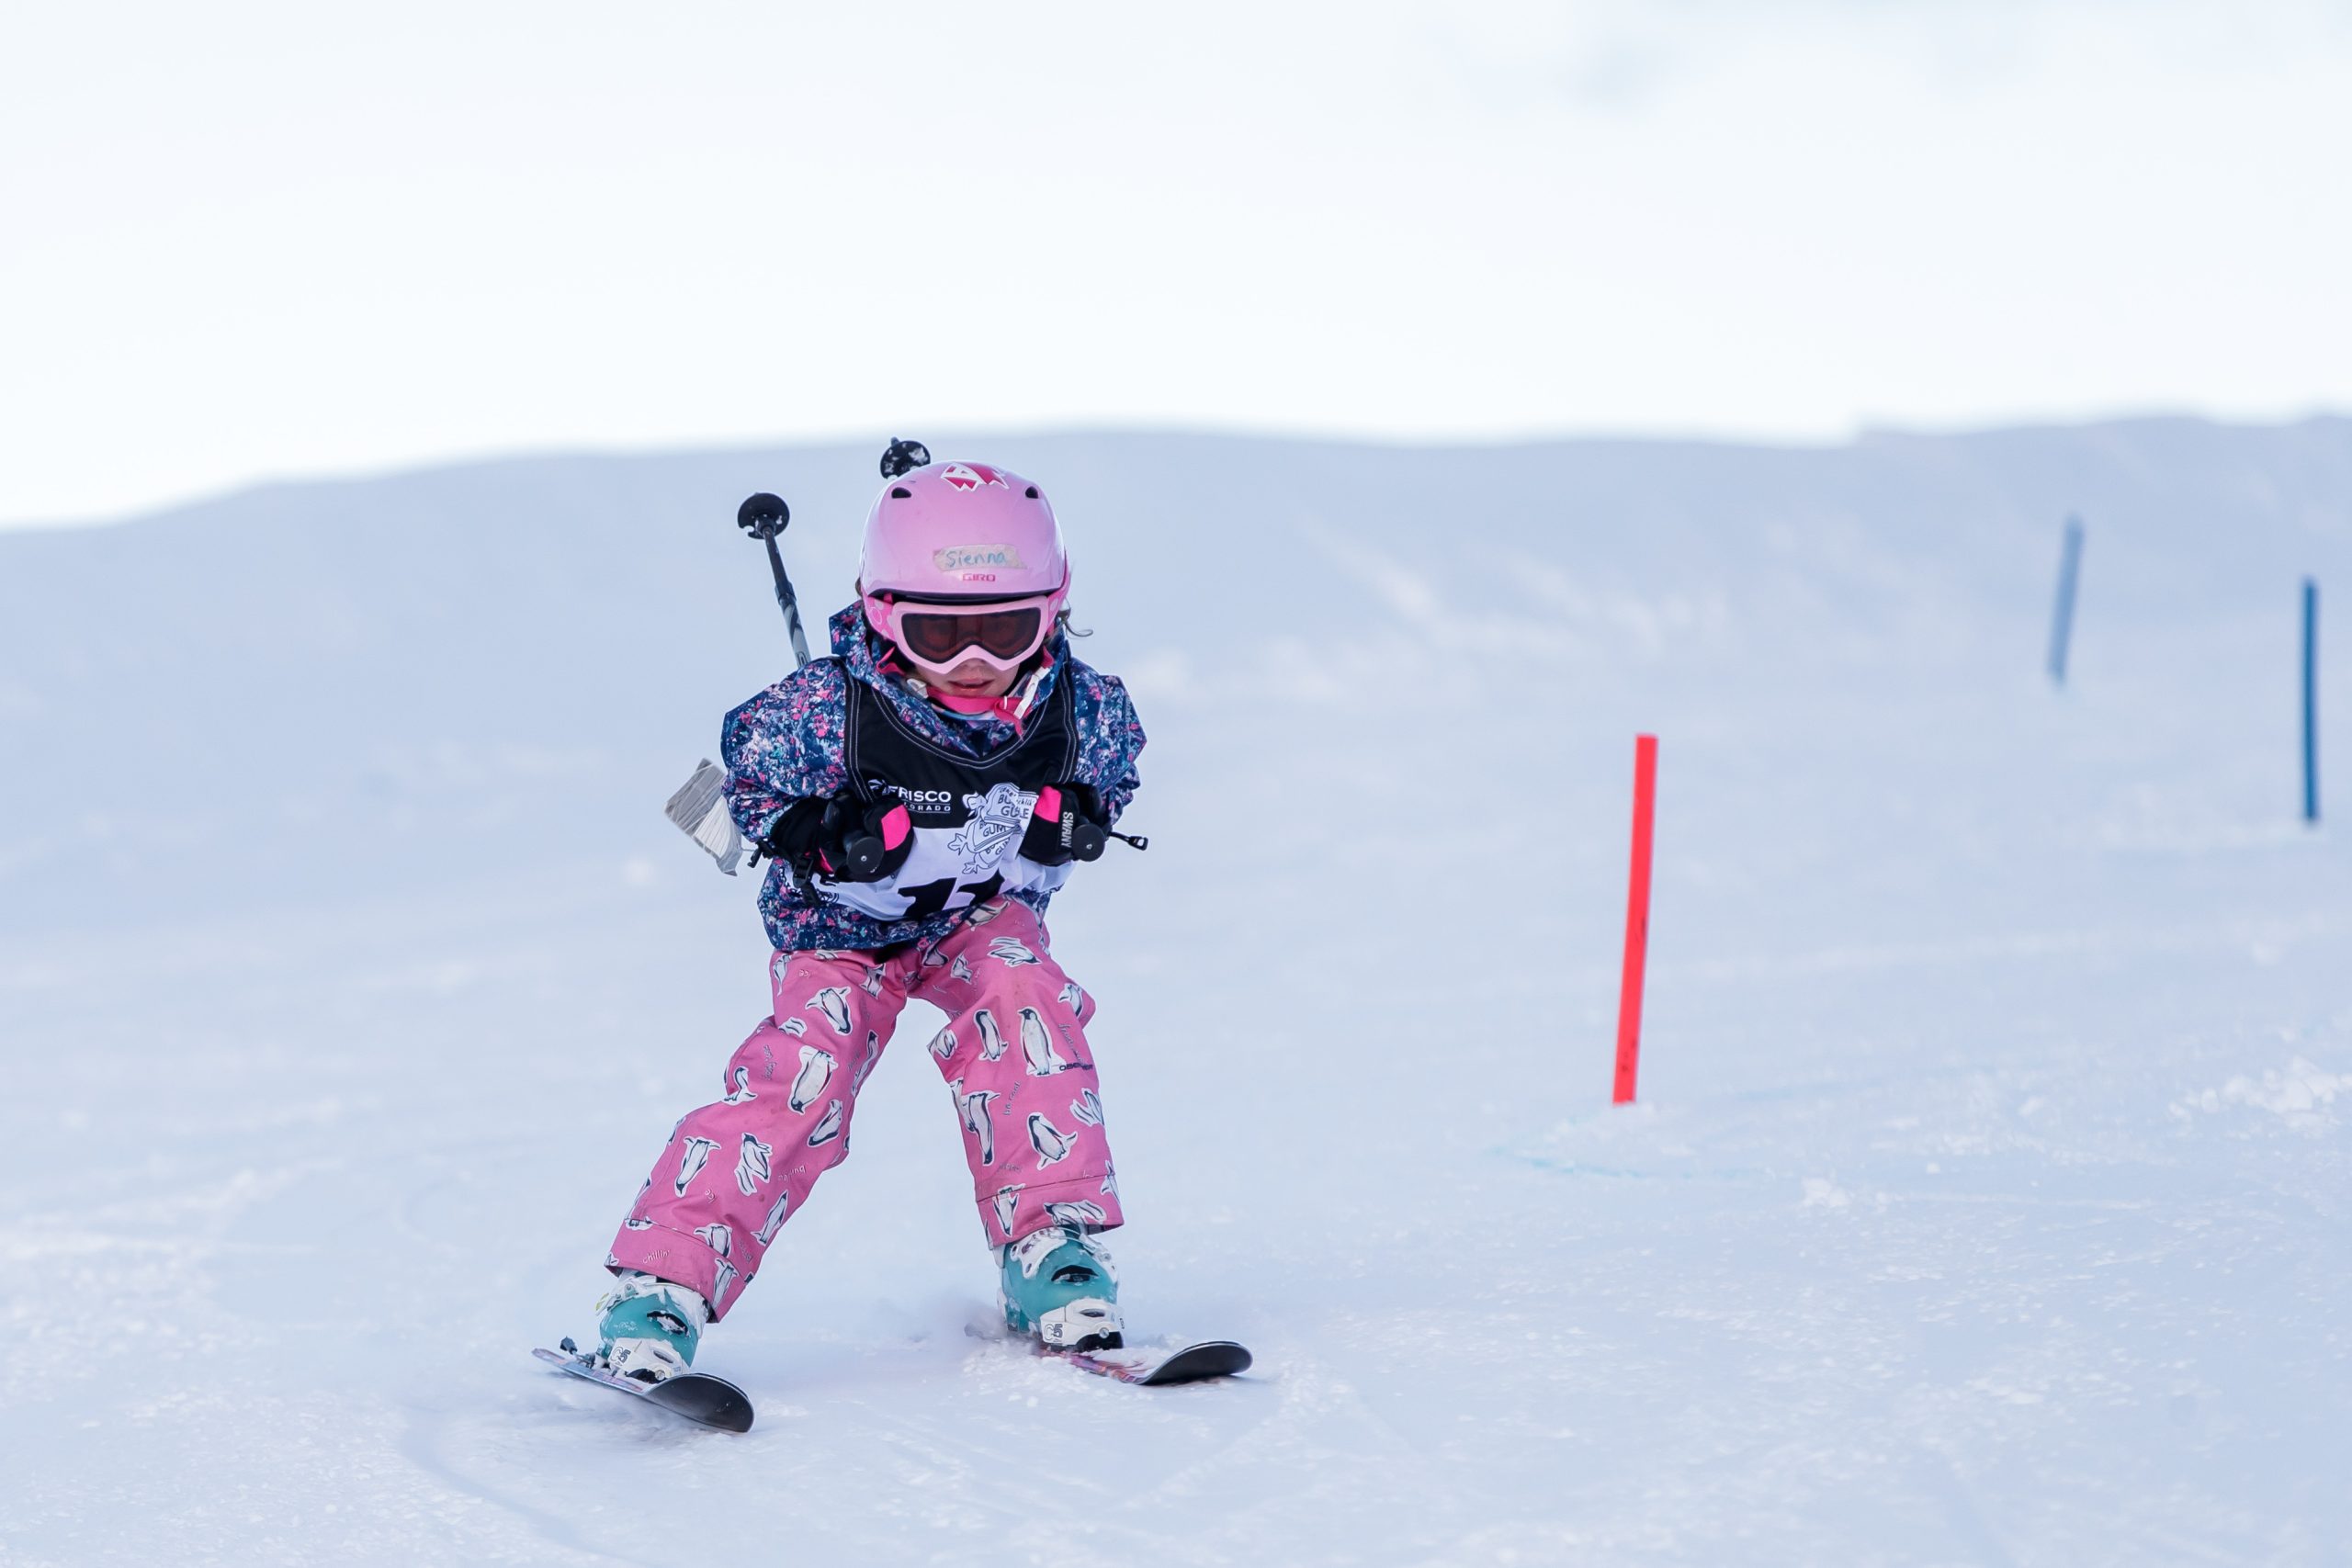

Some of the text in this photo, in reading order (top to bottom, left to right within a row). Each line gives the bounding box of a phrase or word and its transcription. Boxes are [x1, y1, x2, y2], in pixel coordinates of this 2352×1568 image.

[946, 551, 1006, 568] Sienna
[962, 573, 996, 581] GIRO
[888, 785, 952, 803] FRISCO
[1061, 811, 1073, 848] SWANY
